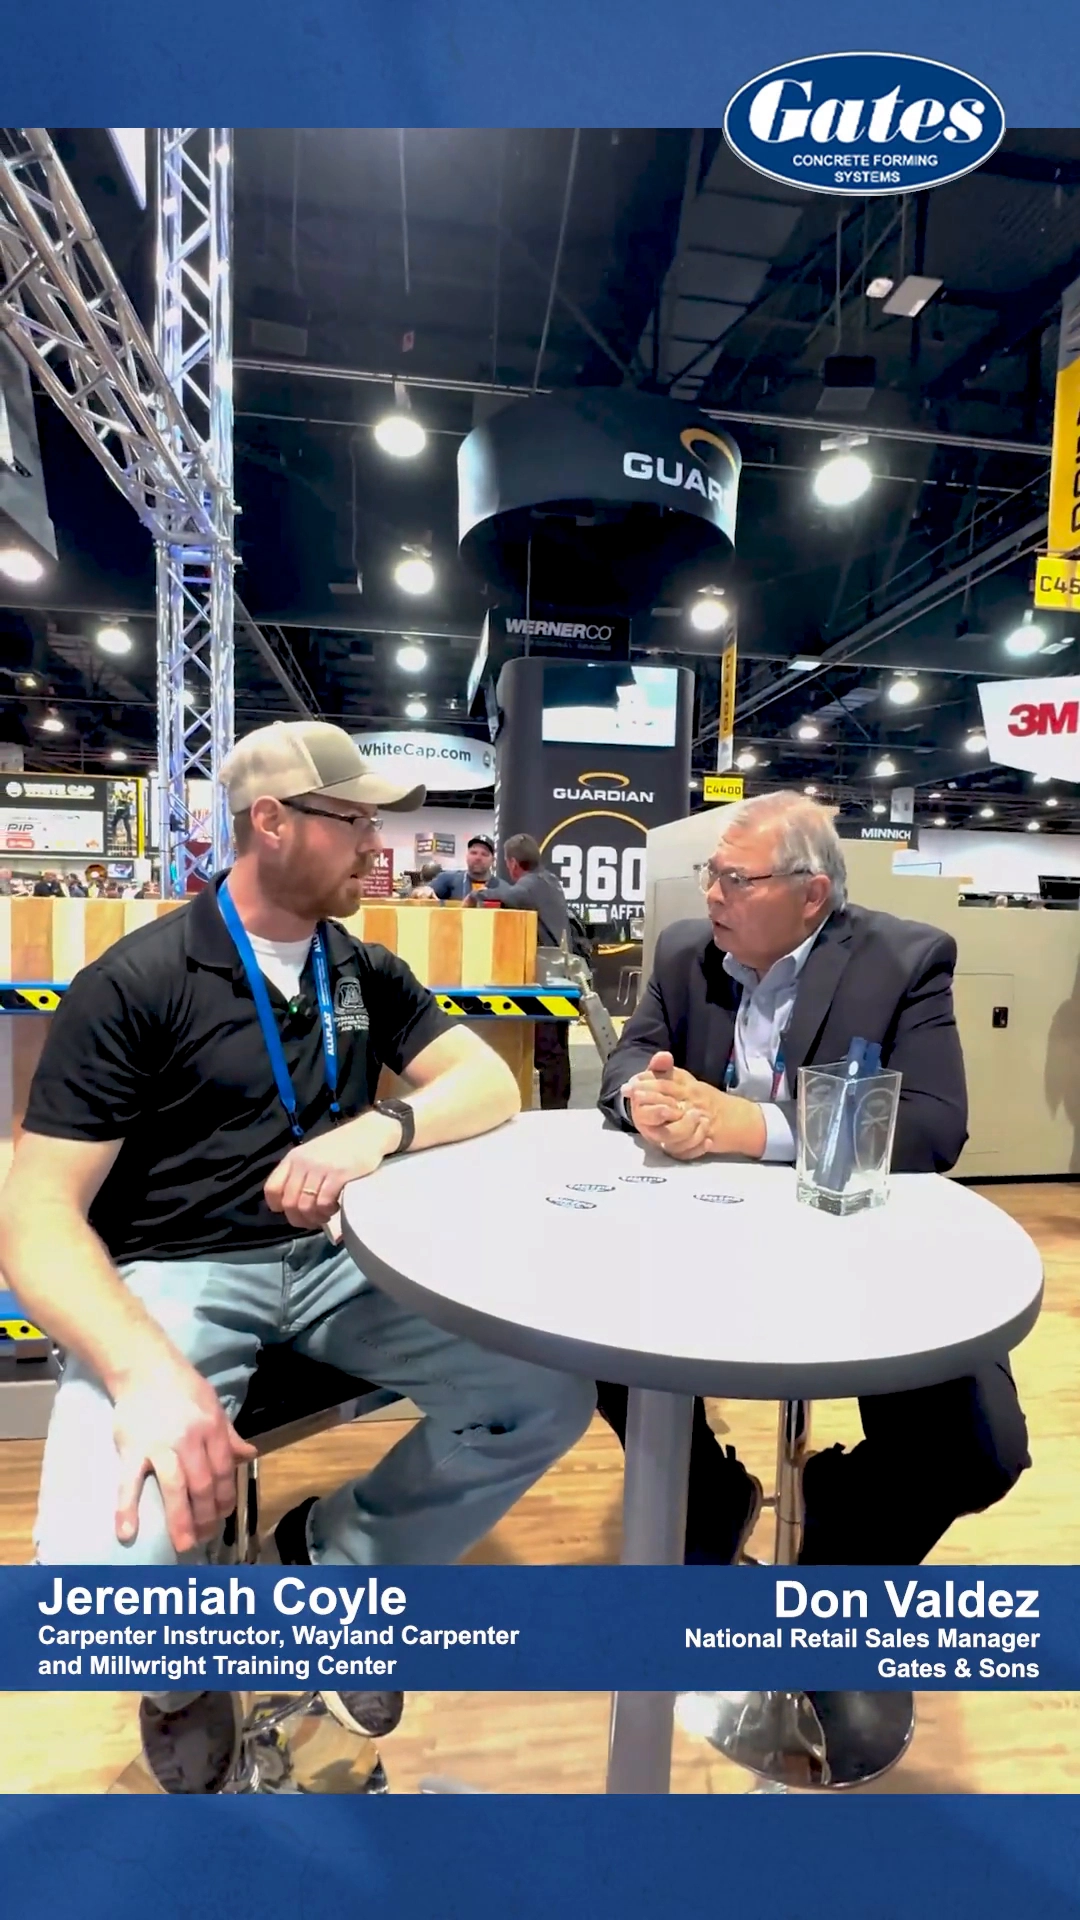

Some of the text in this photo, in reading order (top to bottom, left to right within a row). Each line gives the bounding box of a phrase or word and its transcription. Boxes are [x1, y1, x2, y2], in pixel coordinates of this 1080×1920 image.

[505, 617, 612, 641] WERNERCO
[1007, 701, 1079, 737] 3M
[358, 742, 472, 762] WhiteCap.com
[553, 787, 654, 803] GUARDIAN
[706, 785, 742, 795] C4400
[861, 828, 912, 840] MINNICH
[552, 844, 647, 902] 360
